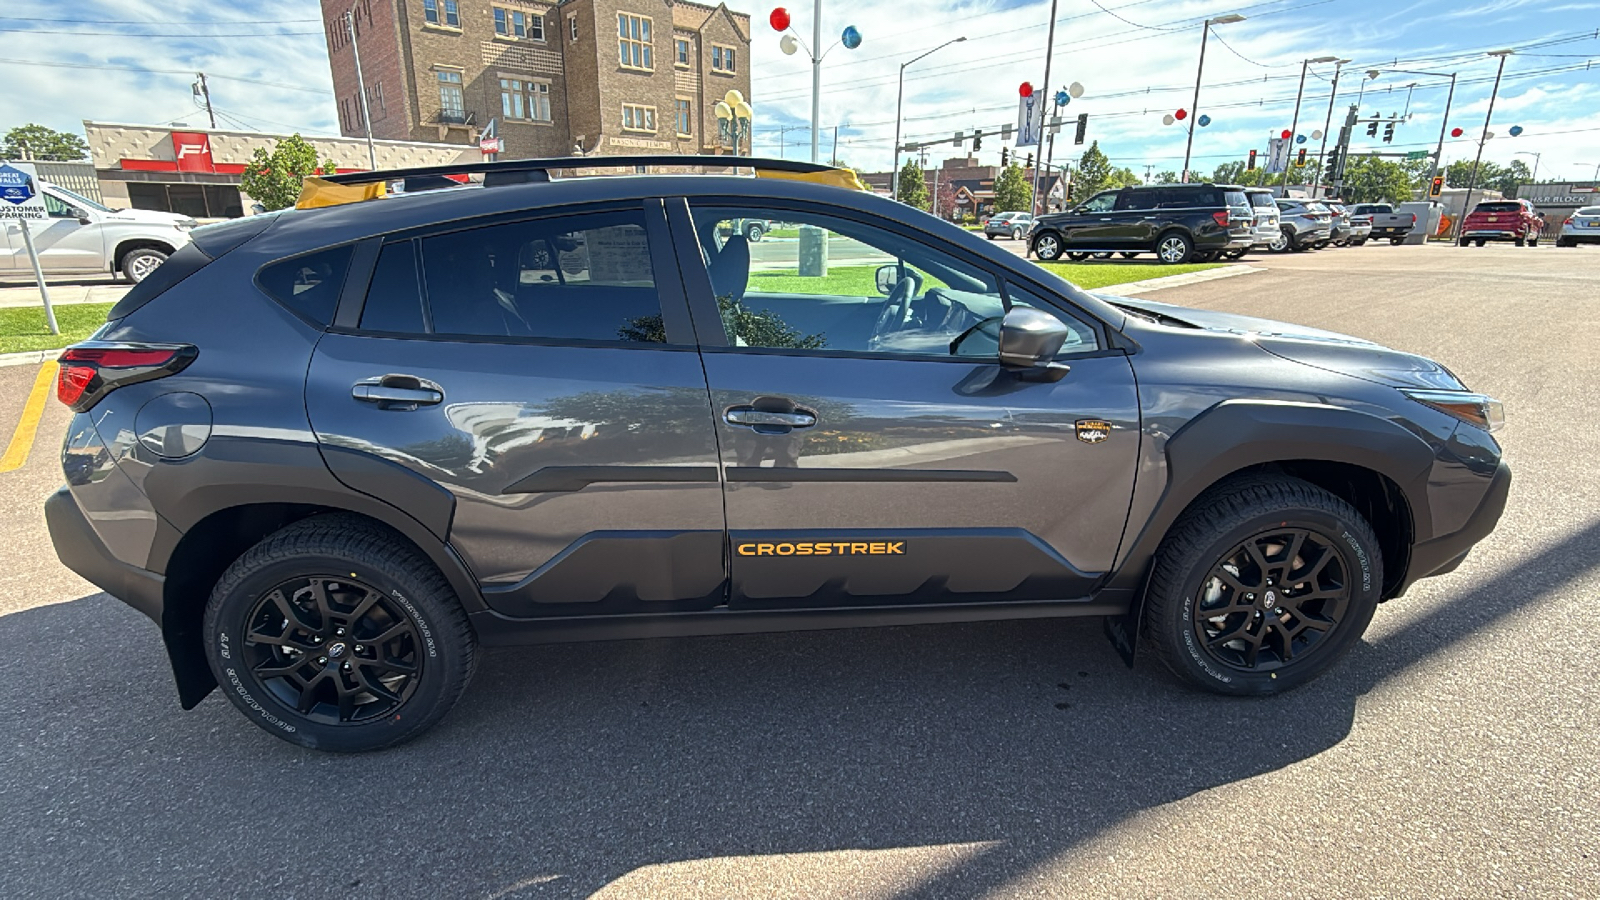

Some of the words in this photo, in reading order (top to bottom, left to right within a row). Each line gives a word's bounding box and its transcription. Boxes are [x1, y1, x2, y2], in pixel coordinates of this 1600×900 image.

[738, 542, 904, 556] CROSSTREK
[1341, 530, 1371, 592] YOKOHAMA
[220, 632, 231, 659] A/T
[391, 589, 437, 658] YOKOHAMA
[1183, 629, 1232, 683] GEOLANDAR
[226, 667, 297, 733] GEOLANDAR
